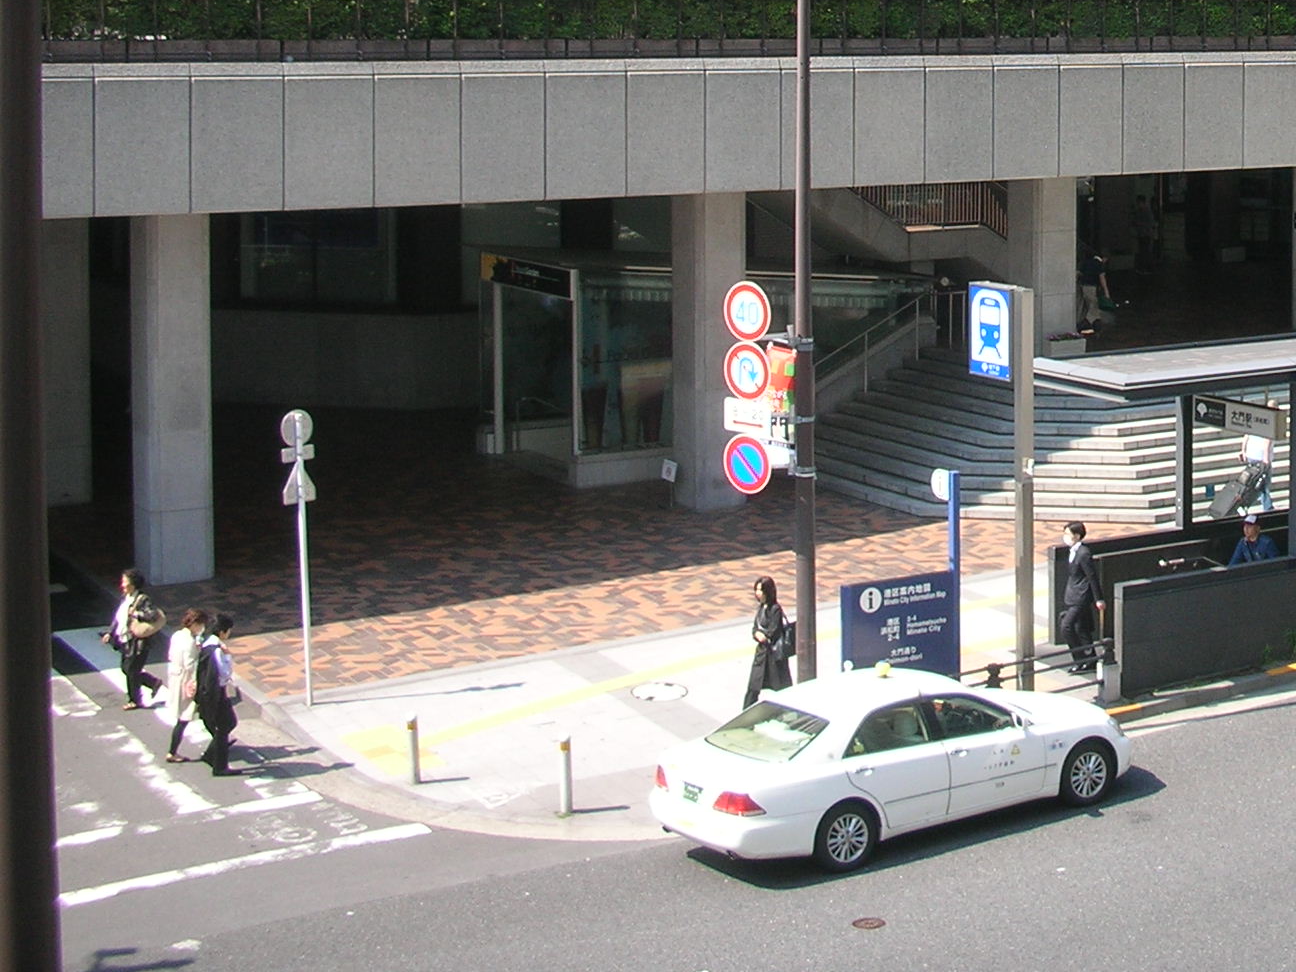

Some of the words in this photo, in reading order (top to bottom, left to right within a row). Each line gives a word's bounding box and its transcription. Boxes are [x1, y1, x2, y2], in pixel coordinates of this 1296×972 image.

[735, 301, 759, 325] 40
[1231, 410, 1252, 423] 大門駅
[883, 583, 931, 598] 港区案内地図
[900, 596, 909, 604] City
[936, 590, 947, 599] Map
[906, 627, 927, 635] Minato
[890, 646, 917, 656] 大門通り
